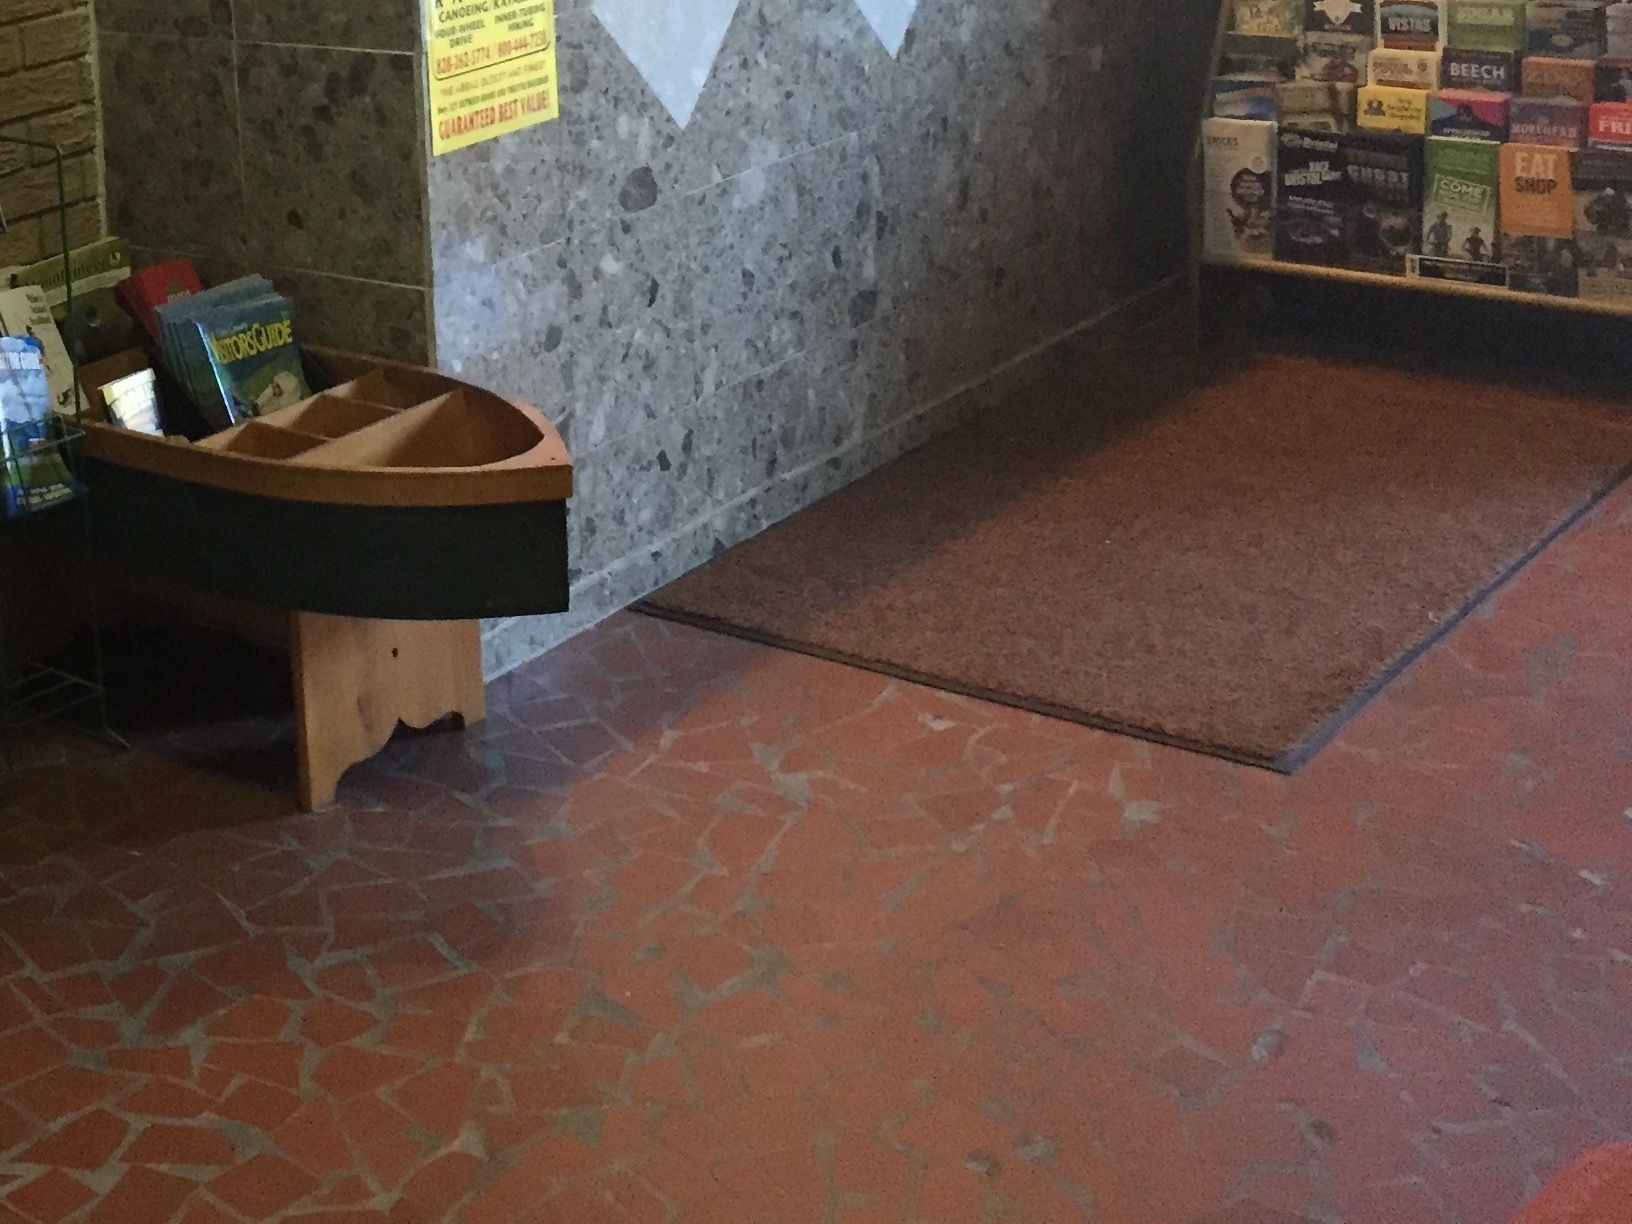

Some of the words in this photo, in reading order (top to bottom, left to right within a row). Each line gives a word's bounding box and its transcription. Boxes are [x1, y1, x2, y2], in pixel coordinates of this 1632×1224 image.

[438, 1, 489, 24] CANOEING
[508, 17, 534, 32] HIKING
[449, 34, 473, 49] DRIVE
[1449, 62, 1506, 80] BEECH
[438, 105, 496, 141] GUARANTEED
[498, 98, 519, 124] BEST
[1515, 151, 1558, 179] EAT
[1439, 179, 1483, 199] COME
[1514, 176, 1558, 195] SHOP
